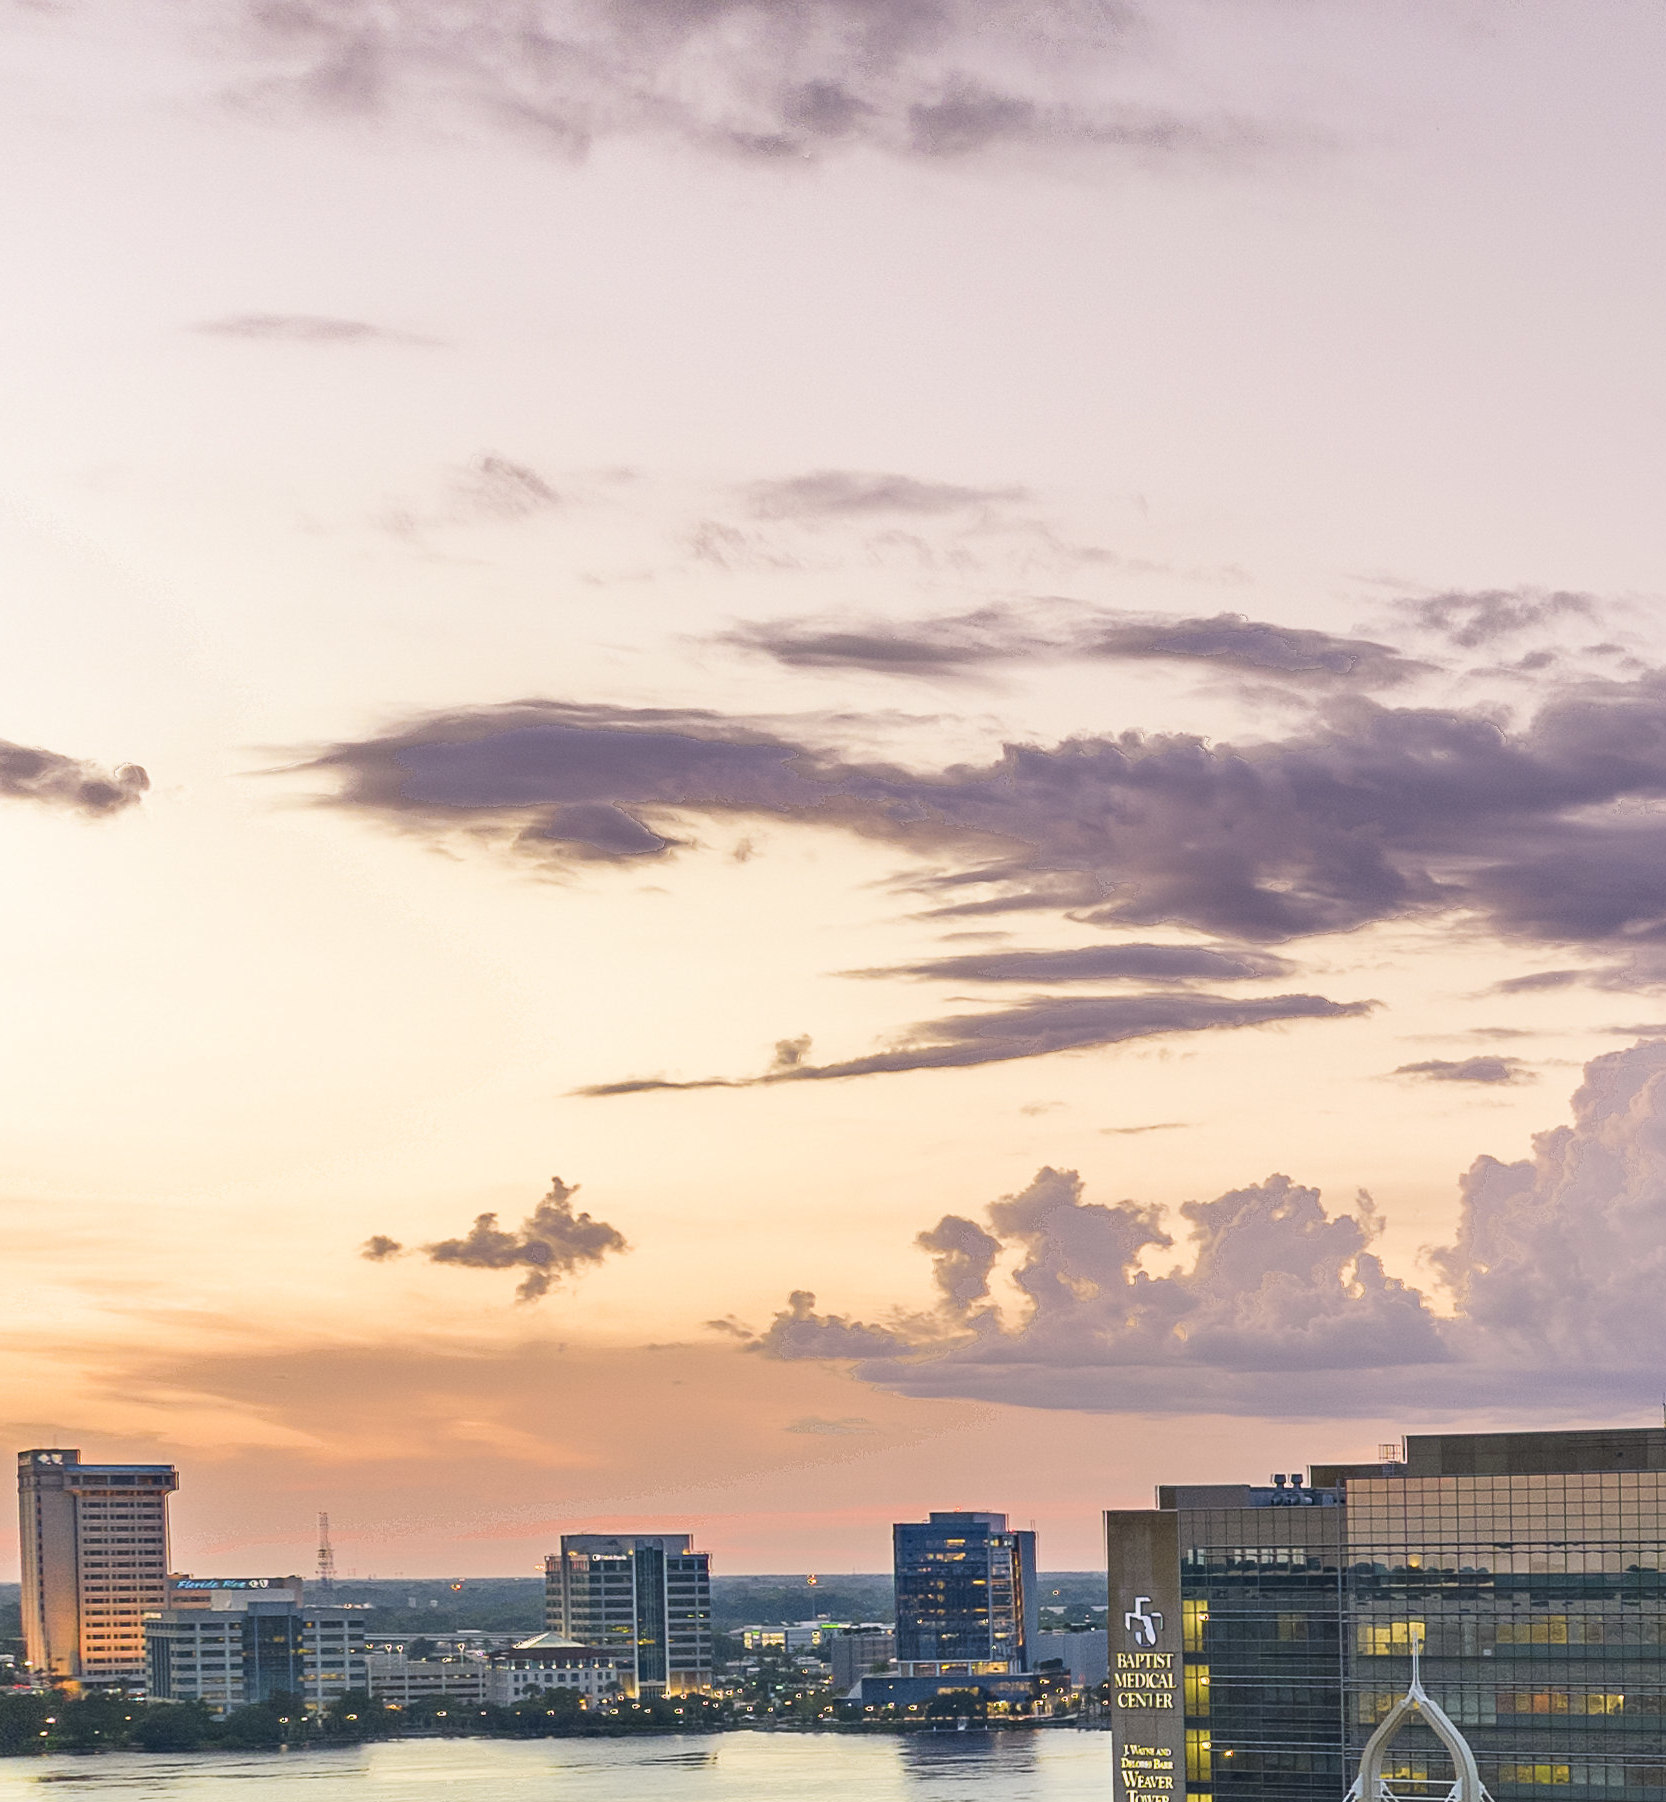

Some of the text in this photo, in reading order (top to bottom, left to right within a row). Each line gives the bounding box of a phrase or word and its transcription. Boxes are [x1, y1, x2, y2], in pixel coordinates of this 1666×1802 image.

[1116, 1653, 1174, 1669] BAPTIST
[1114, 1673, 1177, 1689] MEDICAL
[1117, 1692, 1174, 1709] CENTER
[1121, 1771, 1173, 1790] WEAVER
